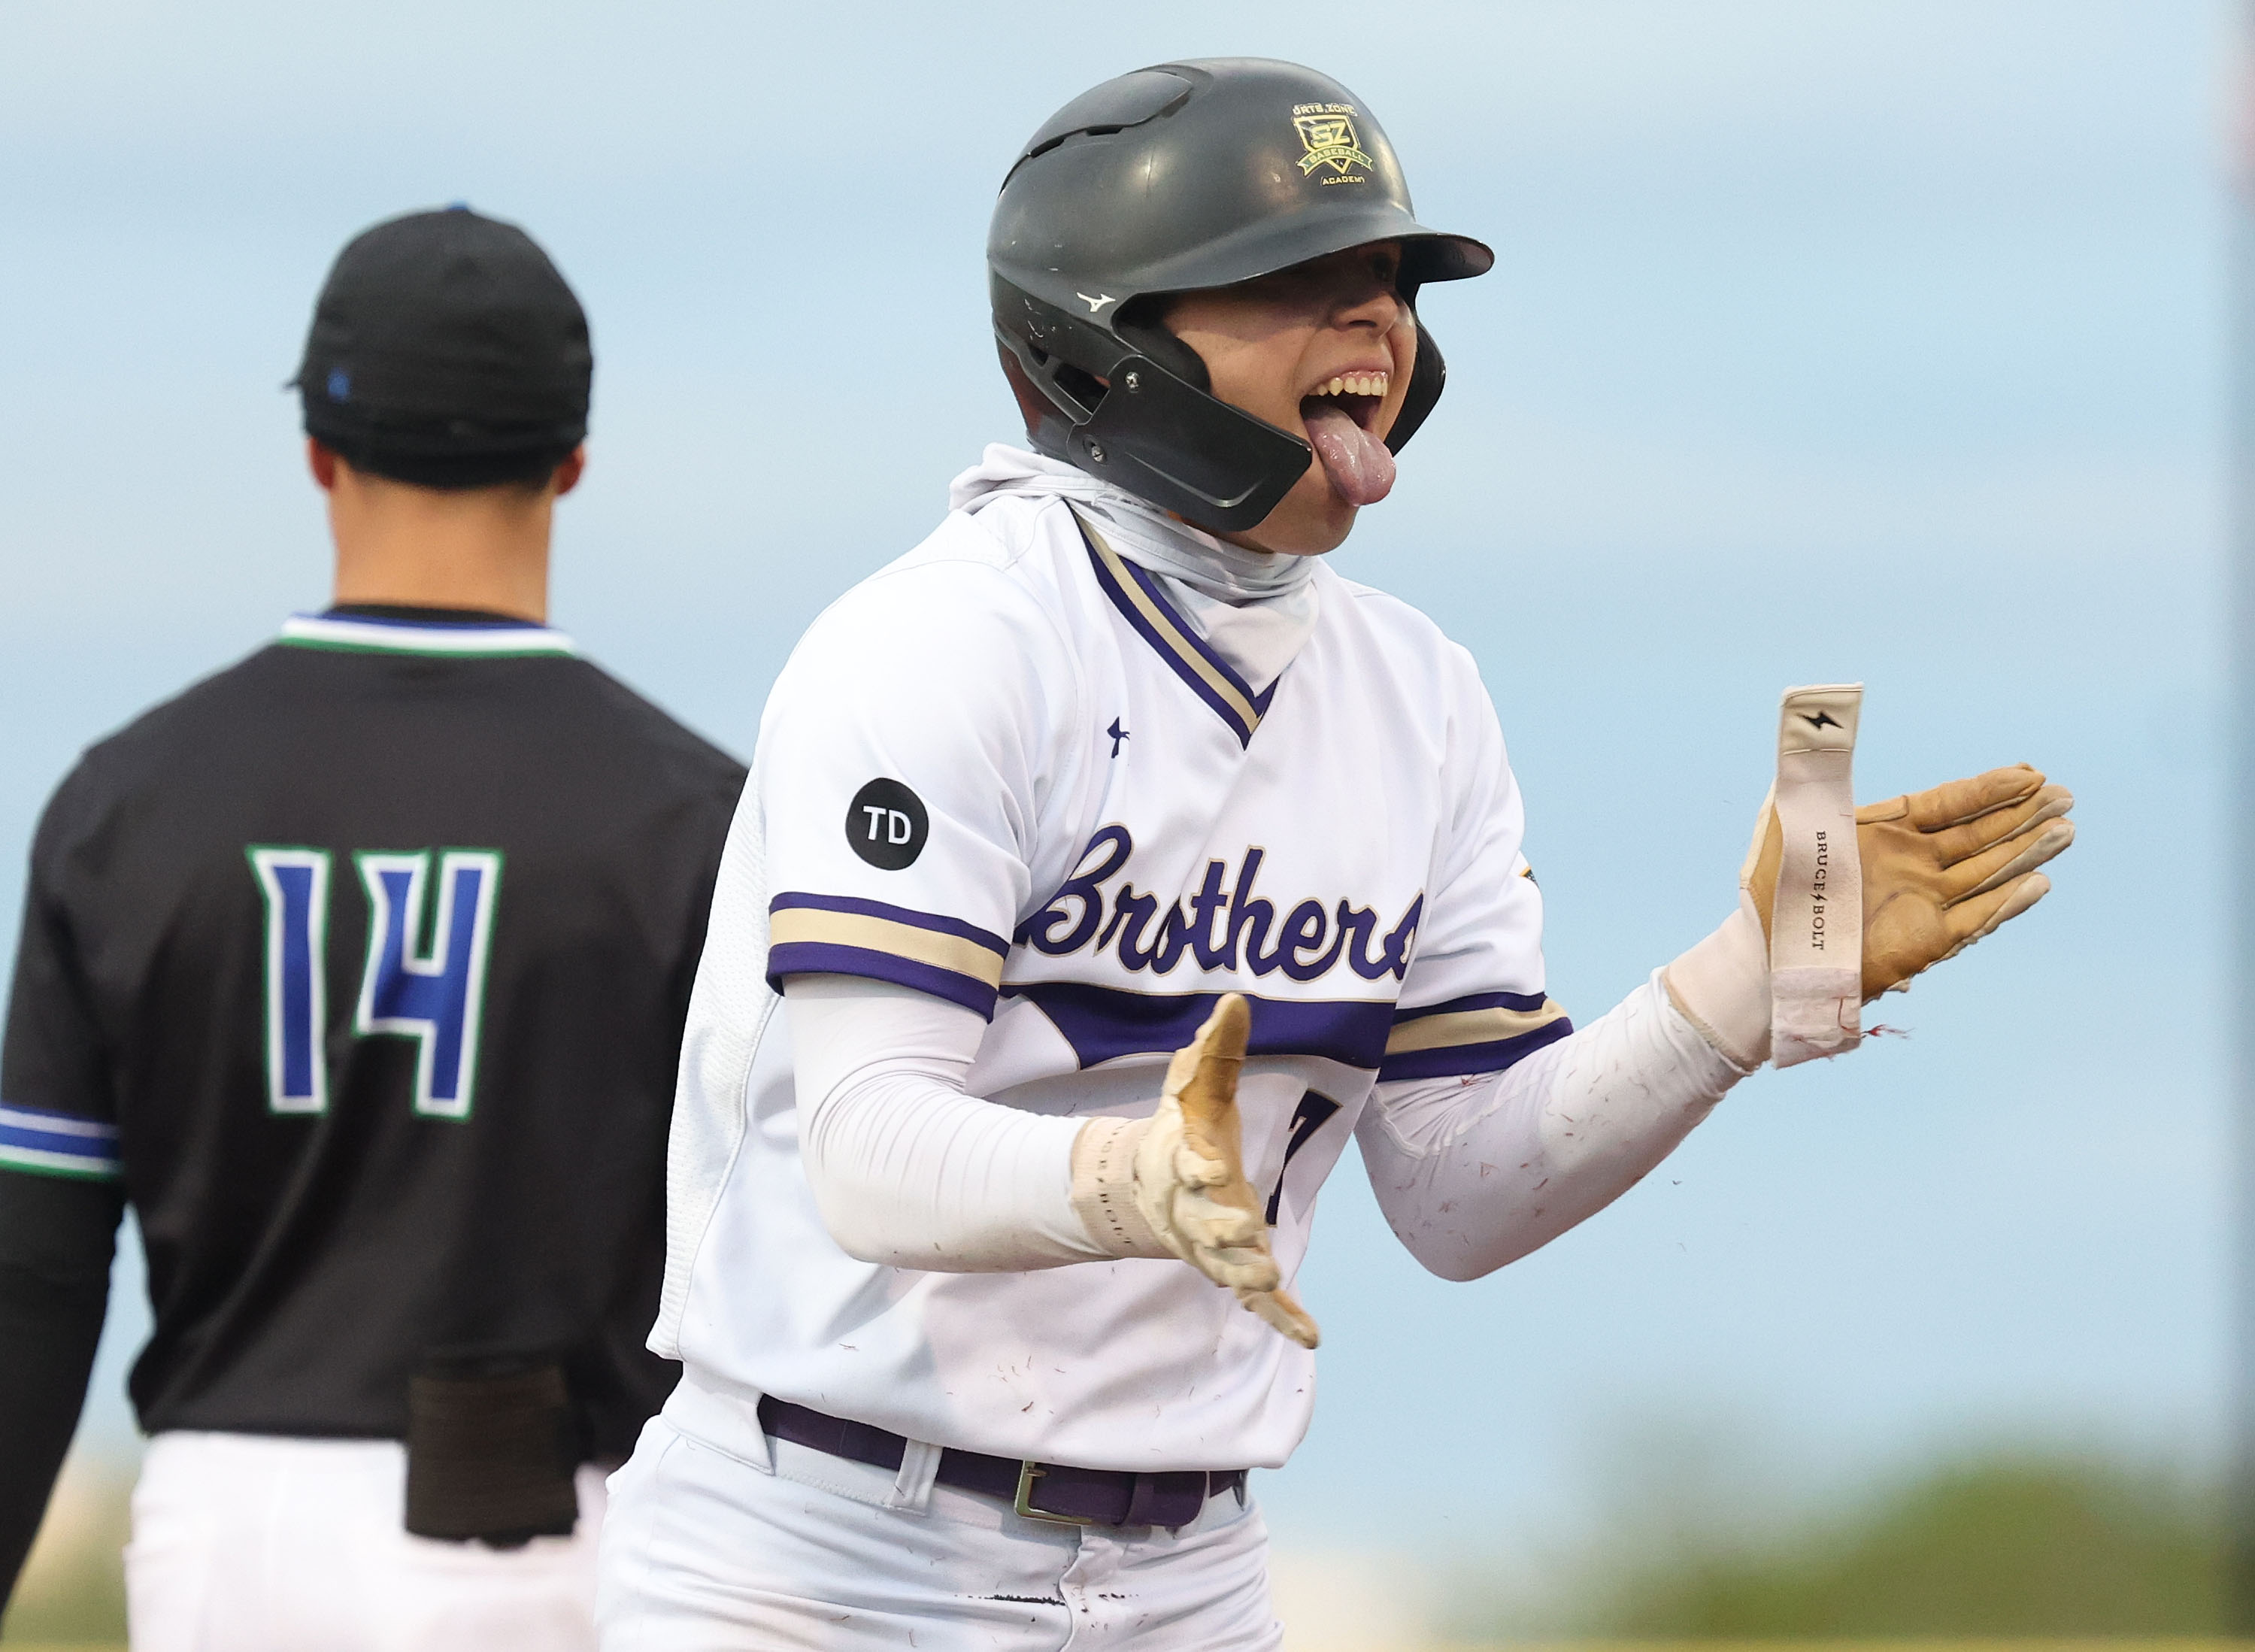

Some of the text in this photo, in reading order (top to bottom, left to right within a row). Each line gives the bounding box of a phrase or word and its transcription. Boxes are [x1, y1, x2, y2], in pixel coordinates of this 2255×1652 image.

[1311, 120, 1350, 148] SZ
[1308, 147, 1364, 163] BASEBALL
[862, 805, 912, 845] TD
[1811, 830, 1828, 950] BRUCE BOLT
[244, 844, 505, 1120] 14
